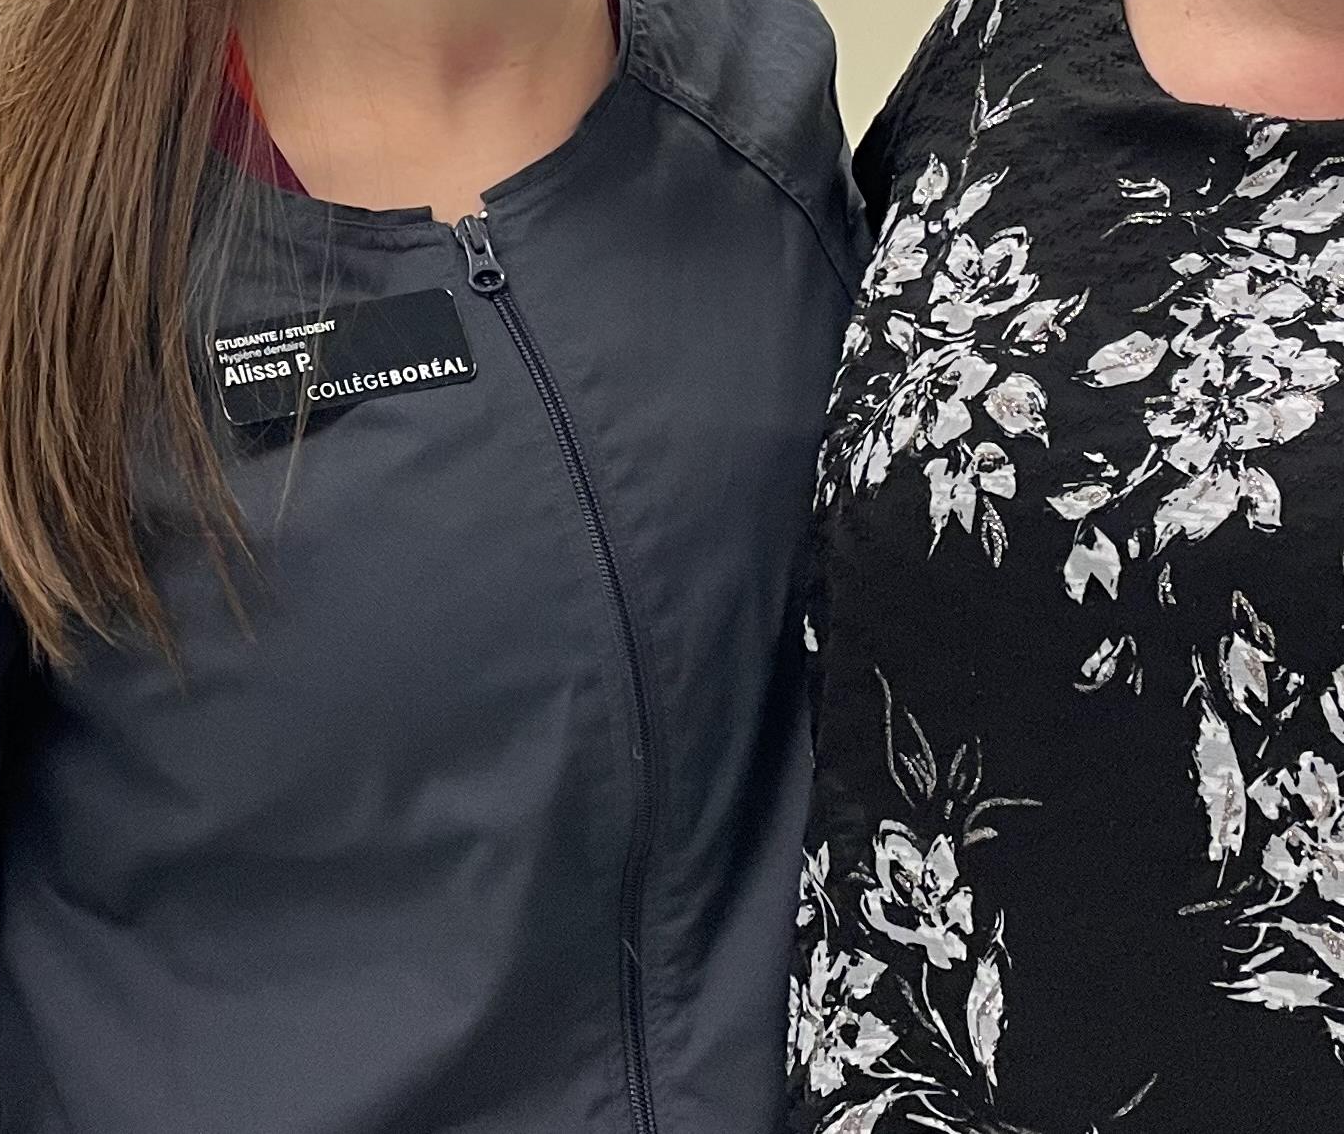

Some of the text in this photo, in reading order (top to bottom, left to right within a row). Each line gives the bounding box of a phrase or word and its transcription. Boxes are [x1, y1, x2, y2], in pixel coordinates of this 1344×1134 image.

[216, 331, 278, 351] ÉTUDIANTE
[285, 320, 336, 339] STUDENT
[263, 341, 306, 356] dentaire
[225, 360, 291, 386] Alissa
